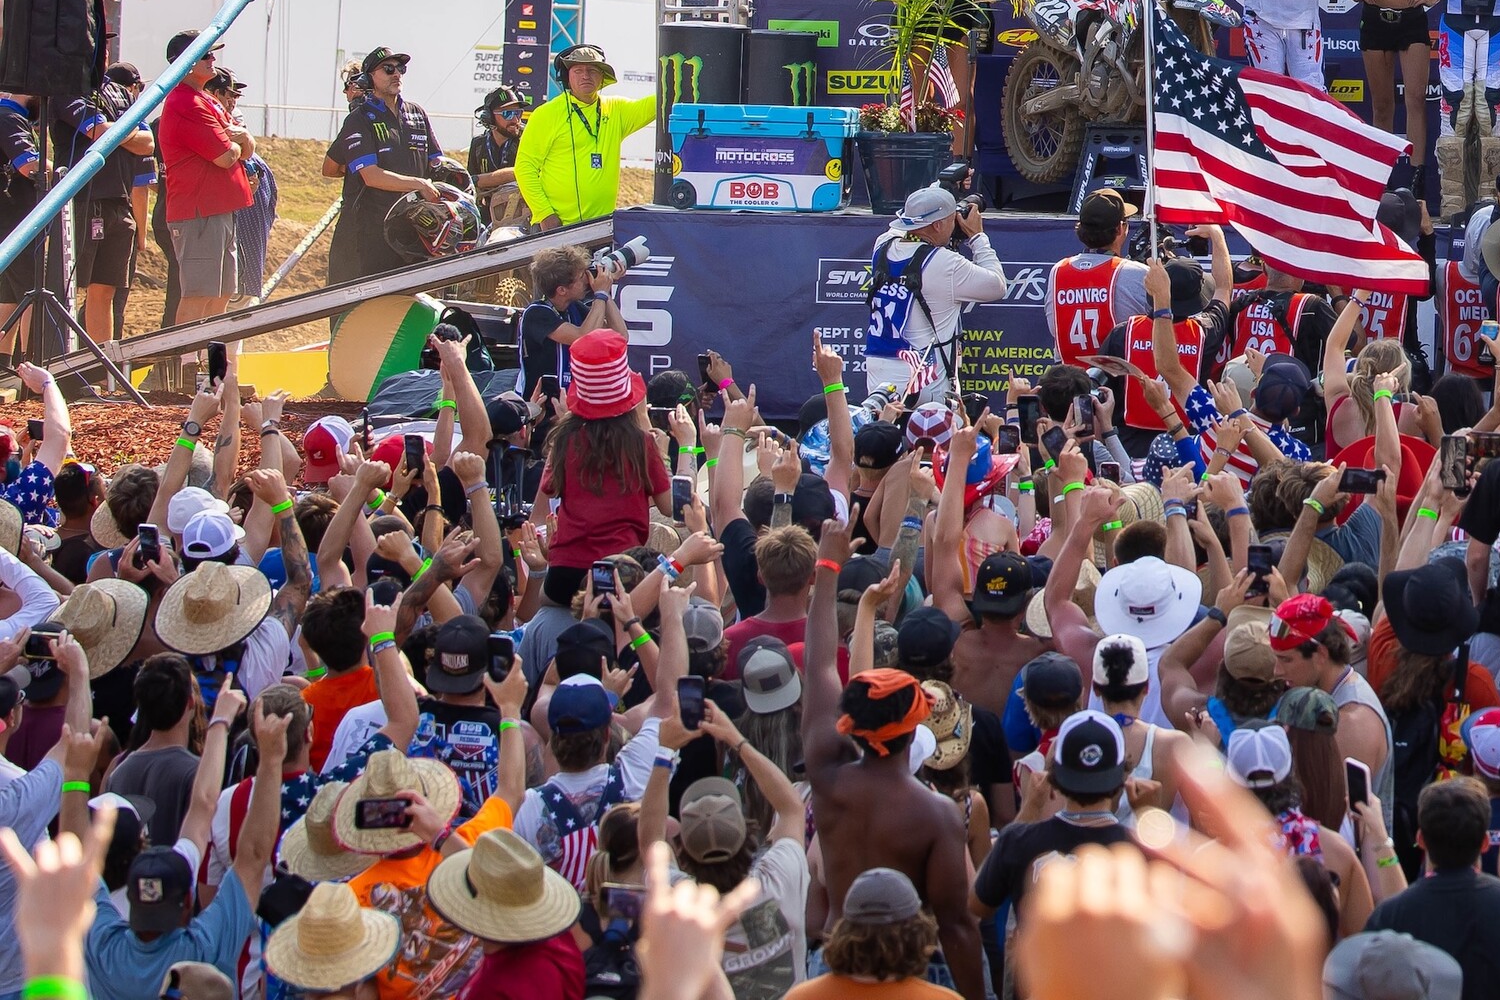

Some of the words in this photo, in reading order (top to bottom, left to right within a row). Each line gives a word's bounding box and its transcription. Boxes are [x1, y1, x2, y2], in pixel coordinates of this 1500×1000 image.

[474, 53, 503, 62] SUPER
[475, 62, 503, 72] MOTO
[473, 72, 503, 82] CROSS
[715, 151, 795, 162] MOTOCROSS
[1074, 152, 1095, 214] UFOPLAST
[729, 182, 779, 199] BOB
[1056, 287, 1108, 306] CONVRG
[814, 327, 850, 339] SEPT
[853, 327, 864, 339] 6
[1069, 309, 1100, 350] 47
[1250, 321, 1275, 337] USA
[981, 363, 1010, 375] LAS
